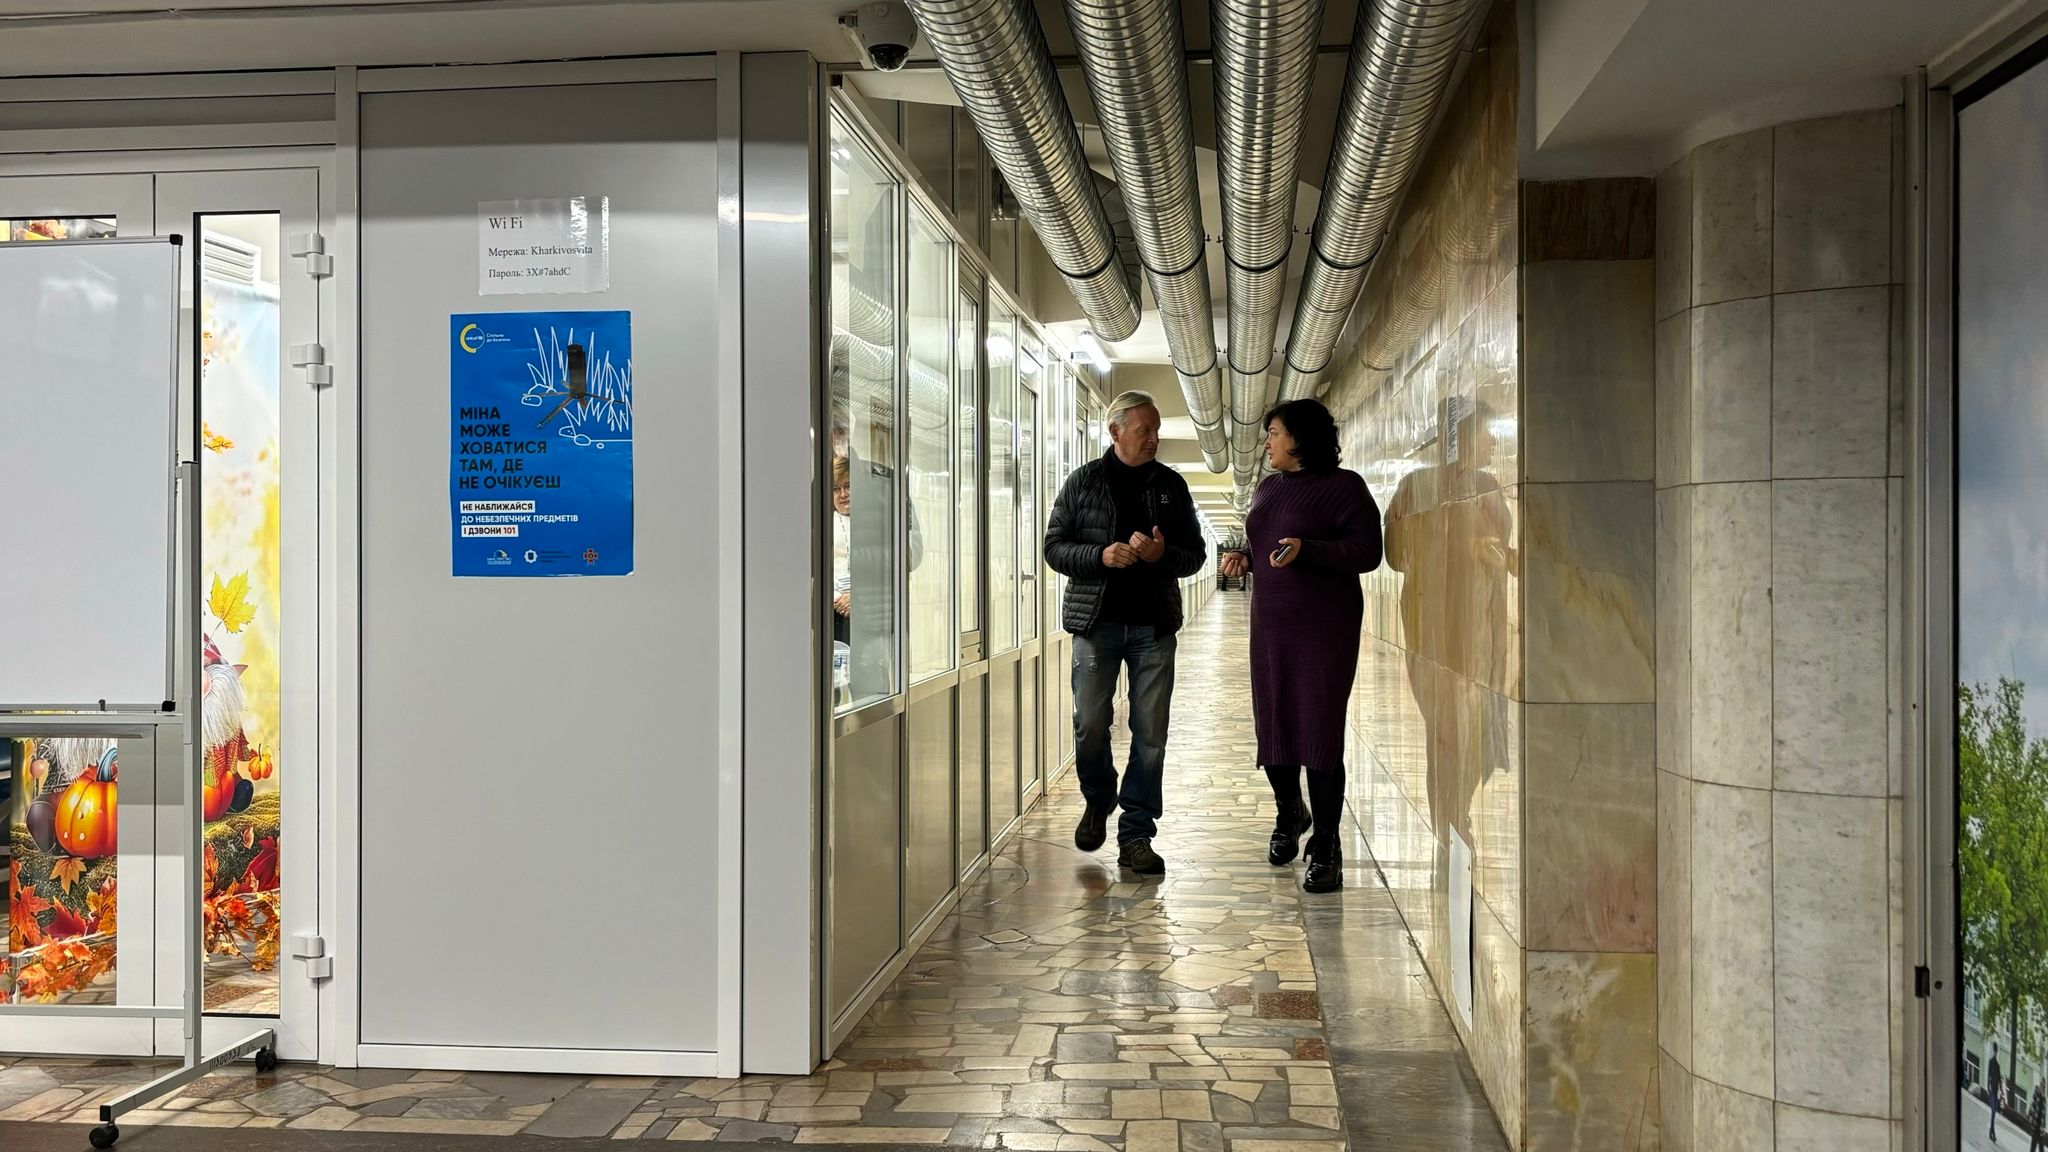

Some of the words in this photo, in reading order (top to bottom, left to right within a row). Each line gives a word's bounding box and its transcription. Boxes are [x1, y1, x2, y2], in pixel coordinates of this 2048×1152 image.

[489, 217, 507, 229] Wi
[511, 216, 523, 229] Fi
[488, 247, 529, 259] Мережа:
[531, 246, 593, 256] Kharkivosvita
[488, 269, 524, 279] Пароль:
[460, 407, 500, 420] МІНА
[460, 424, 511, 437] МОЖЕ
[460, 441, 547, 454] ХОВАТИСЯ
[460, 459, 497, 473] ТАМ,
[502, 459, 523, 473] ДЕ
[459, 476, 479, 489] НЕ
[484, 475, 561, 489] ОЧІКУЄШ
[475, 502, 533, 511] НАБЛИЖАЙСЯ
[461, 516, 474, 524] ДО
[475, 515, 531, 523] НЕБЕЗПЕЧНИХ
[533, 515, 578, 523] ПРЕДМЕТІВ
[468, 527, 502, 535] ДЗВОНИ
